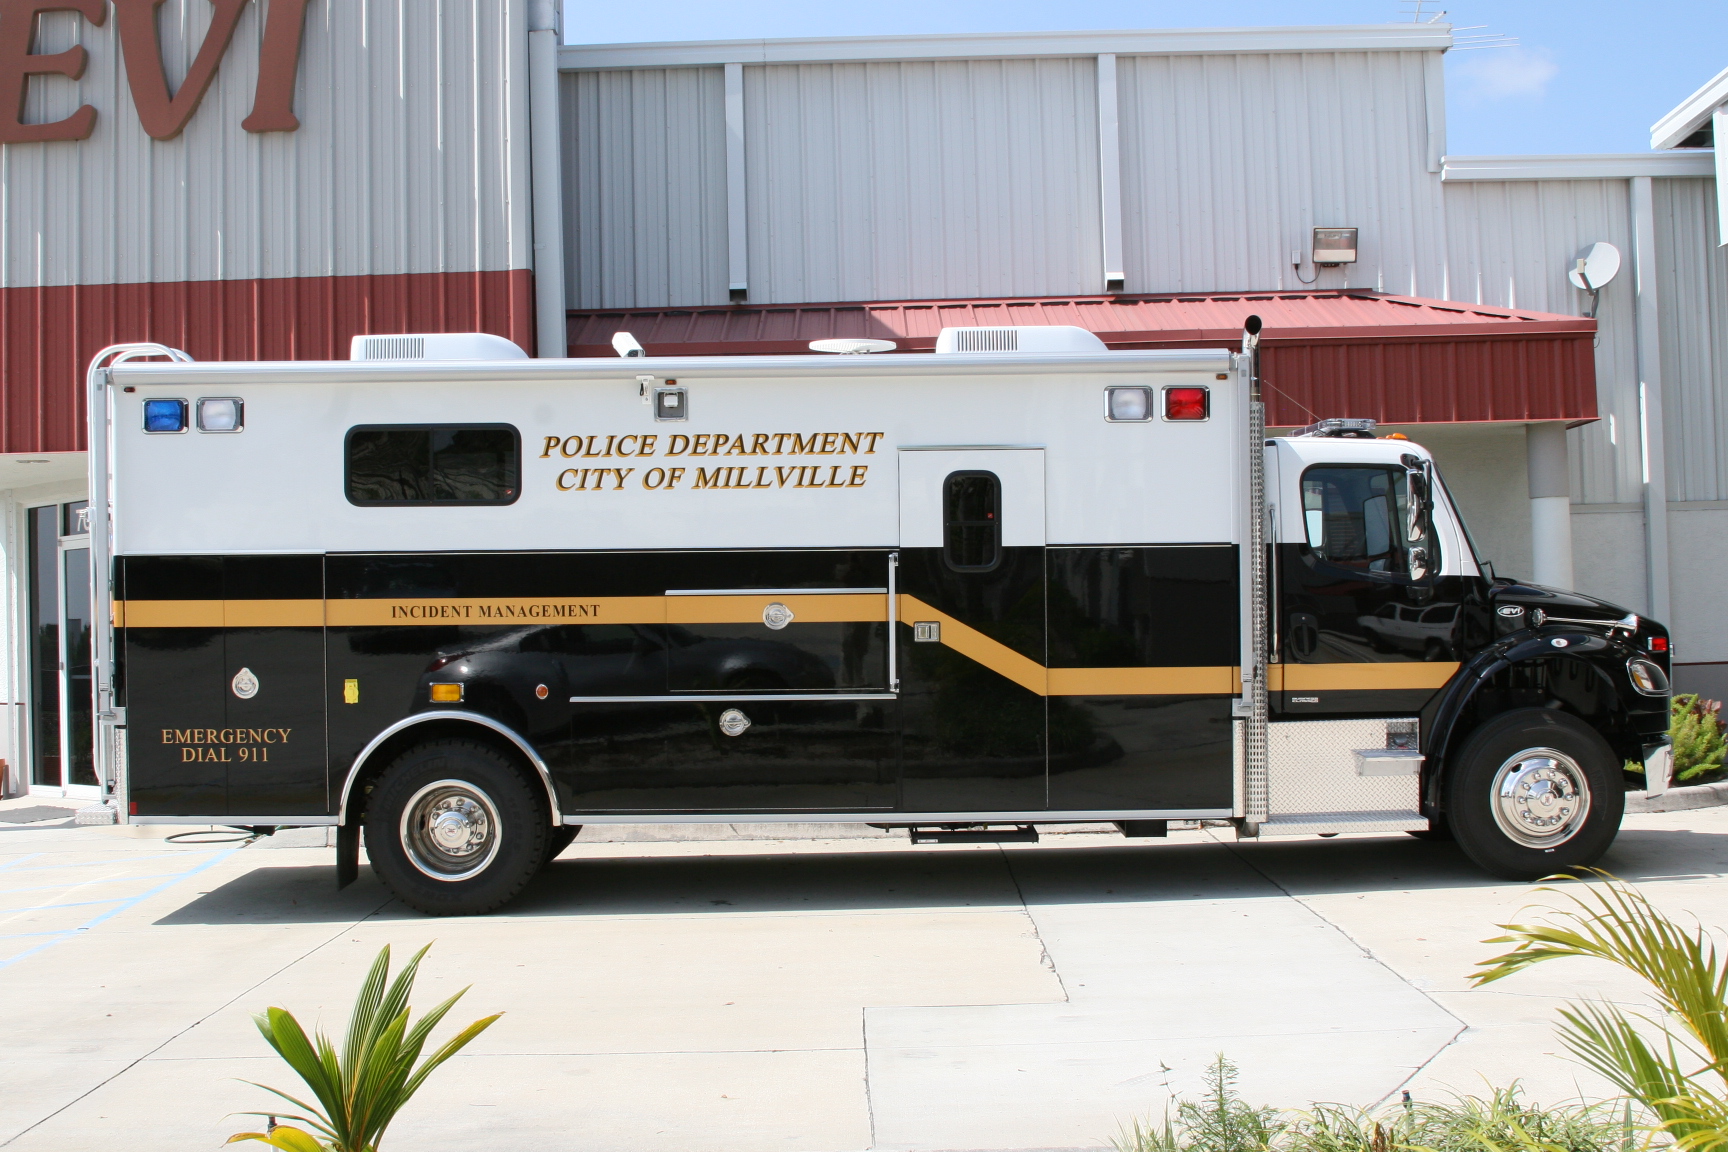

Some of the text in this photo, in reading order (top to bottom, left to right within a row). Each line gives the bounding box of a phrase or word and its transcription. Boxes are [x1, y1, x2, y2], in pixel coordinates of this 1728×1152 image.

[0, 0, 306, 141] EVI
[539, 432, 885, 459] POLICE DEPARTMENT
[555, 465, 869, 492] CITY OF MILLVILLE
[391, 604, 600, 619] INCIDENT MANAGEMENT
[161, 728, 292, 744] EMERGENCY
[181, 747, 269, 763] DIAL 911
